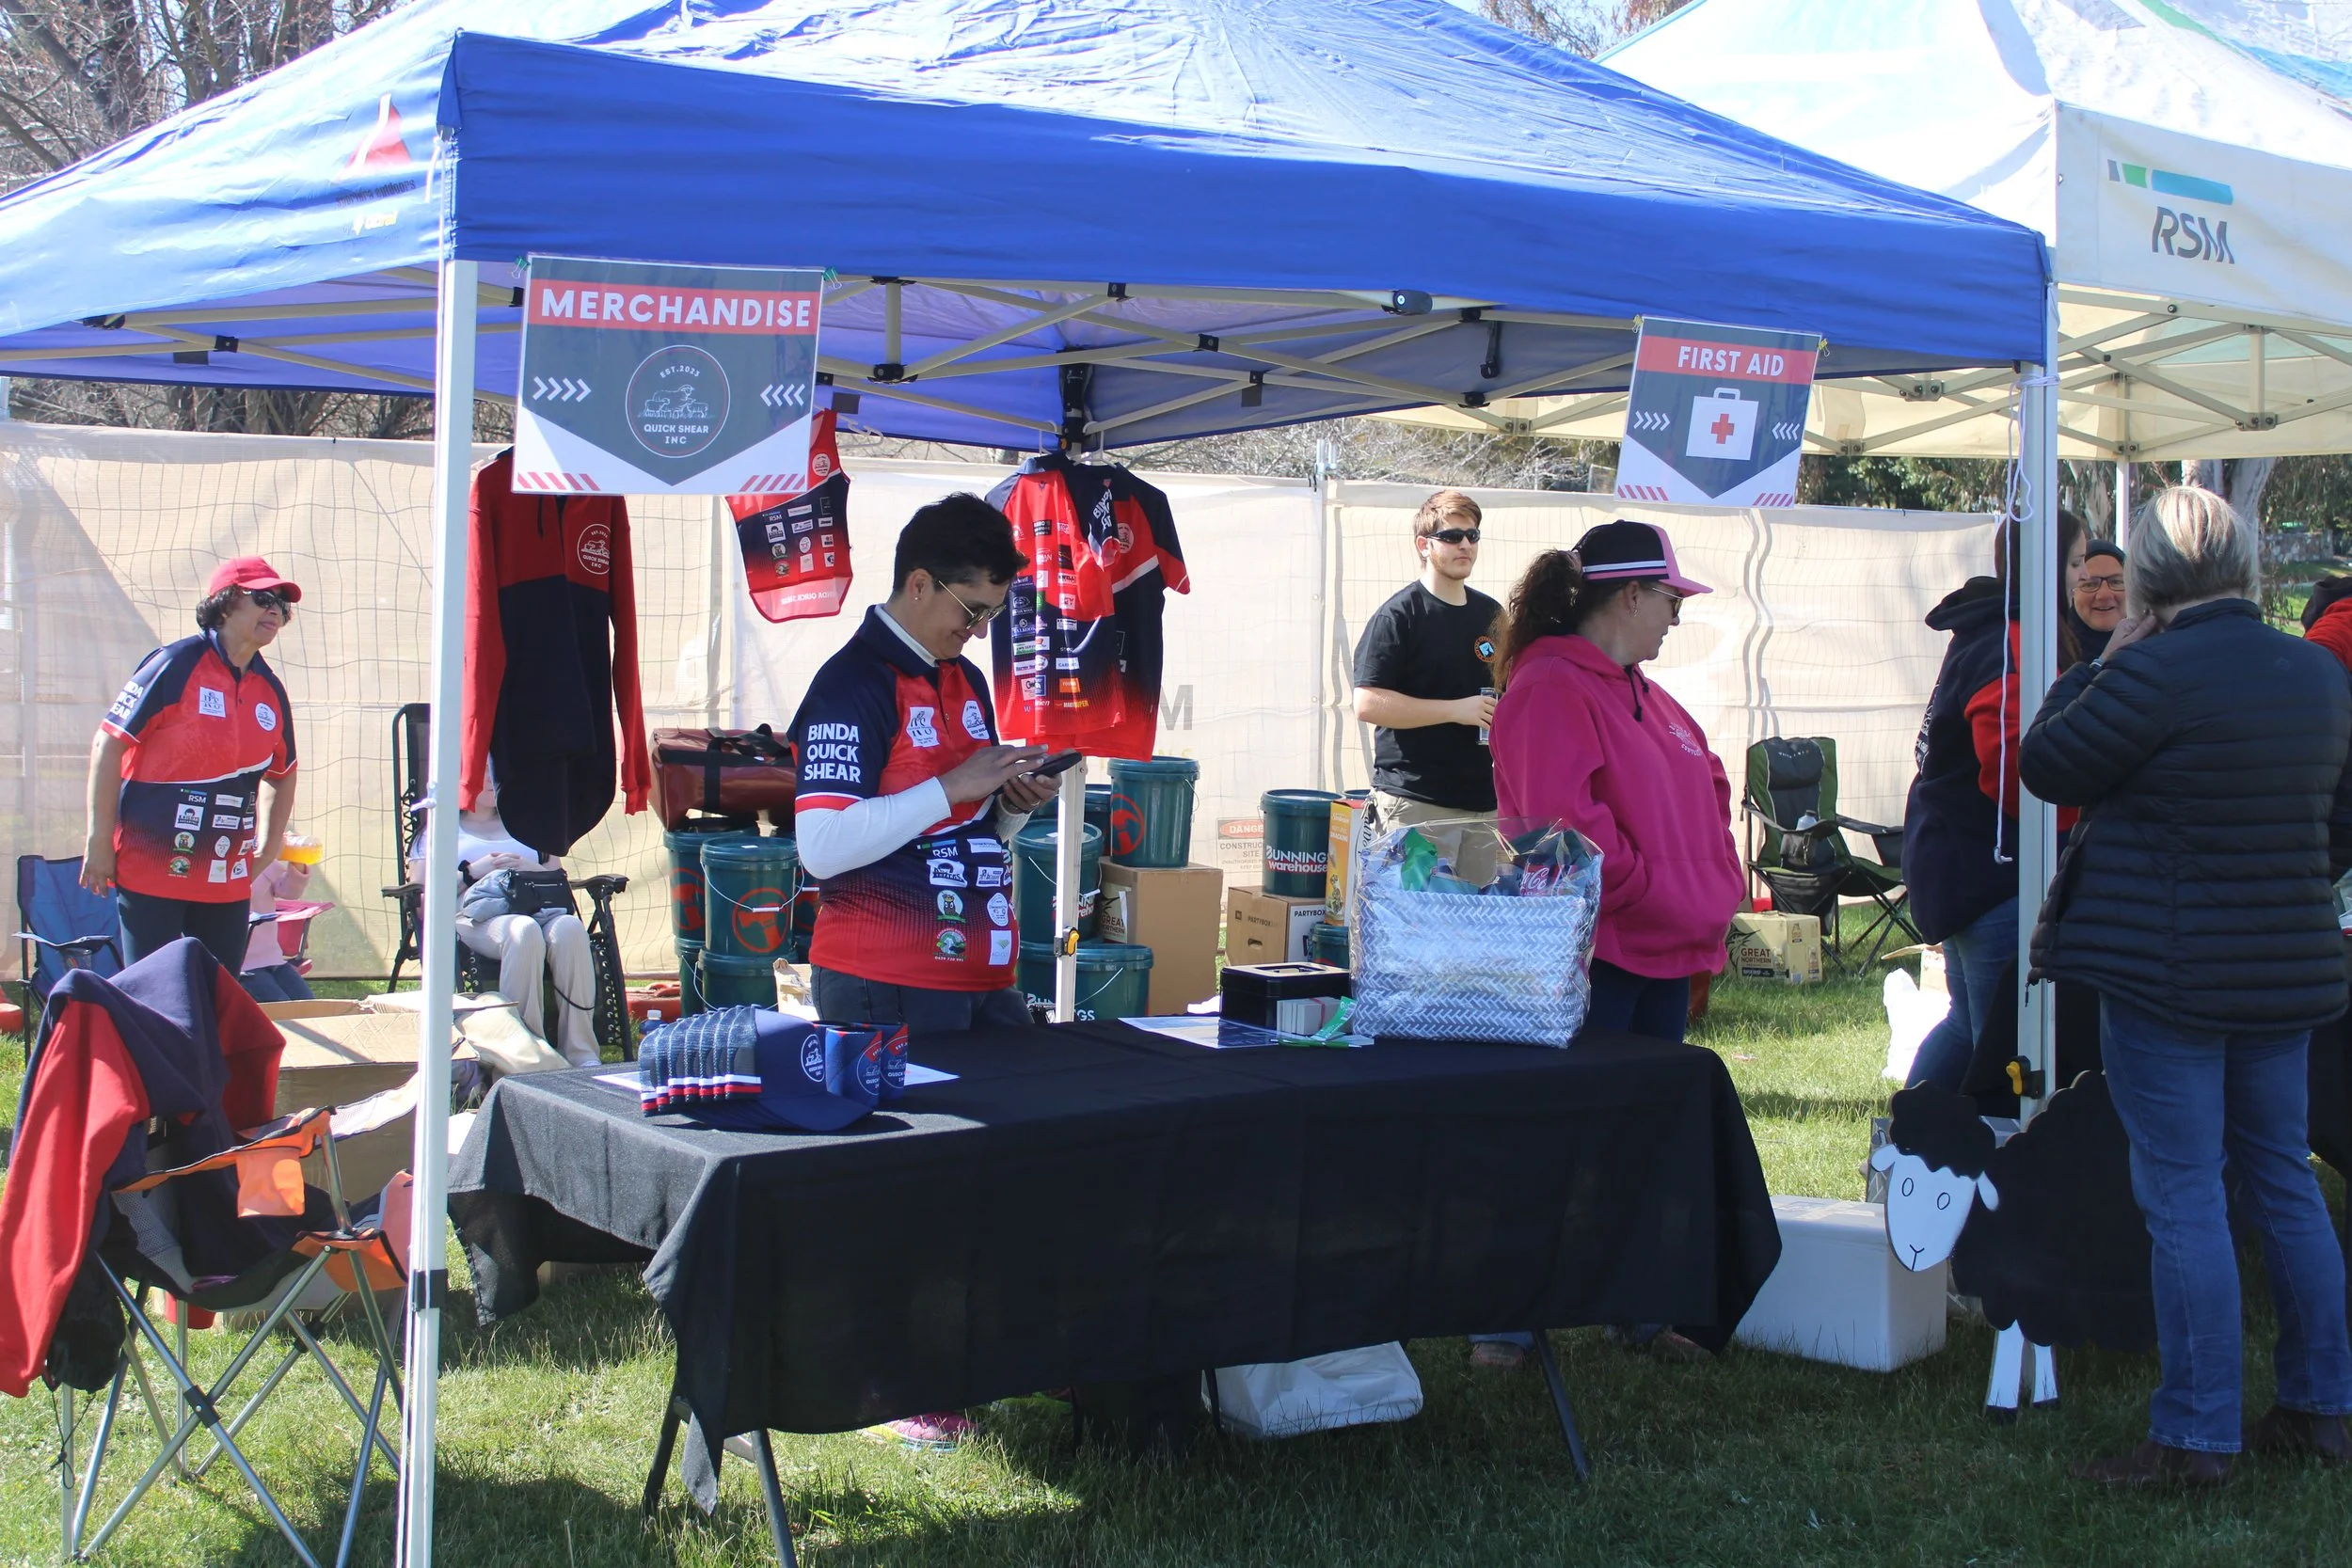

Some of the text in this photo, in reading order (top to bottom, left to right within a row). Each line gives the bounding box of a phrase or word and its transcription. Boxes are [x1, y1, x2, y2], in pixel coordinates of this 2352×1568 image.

[2151, 206, 2235, 264] RSM
[540, 288, 812, 328] MERCHANDISE
[1677, 345, 1785, 377] FIRST AID
[660, 365, 701, 378] EST.2023
[644, 423, 709, 434] QUICK SHEAR
[664, 436, 688, 445] INC
[807, 722, 860, 743] BINDA
[806, 743, 859, 764] QUICK
[803, 763, 862, 784] SHEAR
[188, 794, 207, 804] RSM
[1229, 824, 1264, 834] DANGE
[932, 847, 959, 858] RSM
[1219, 842, 1263, 850] CONSTRUC
[1265, 845, 1327, 863] BUNNING
[1268, 860, 1327, 873] warehouse
[1248, 915, 1271, 927] PARTYBOX
[1740, 947, 1771, 958] GREAT
